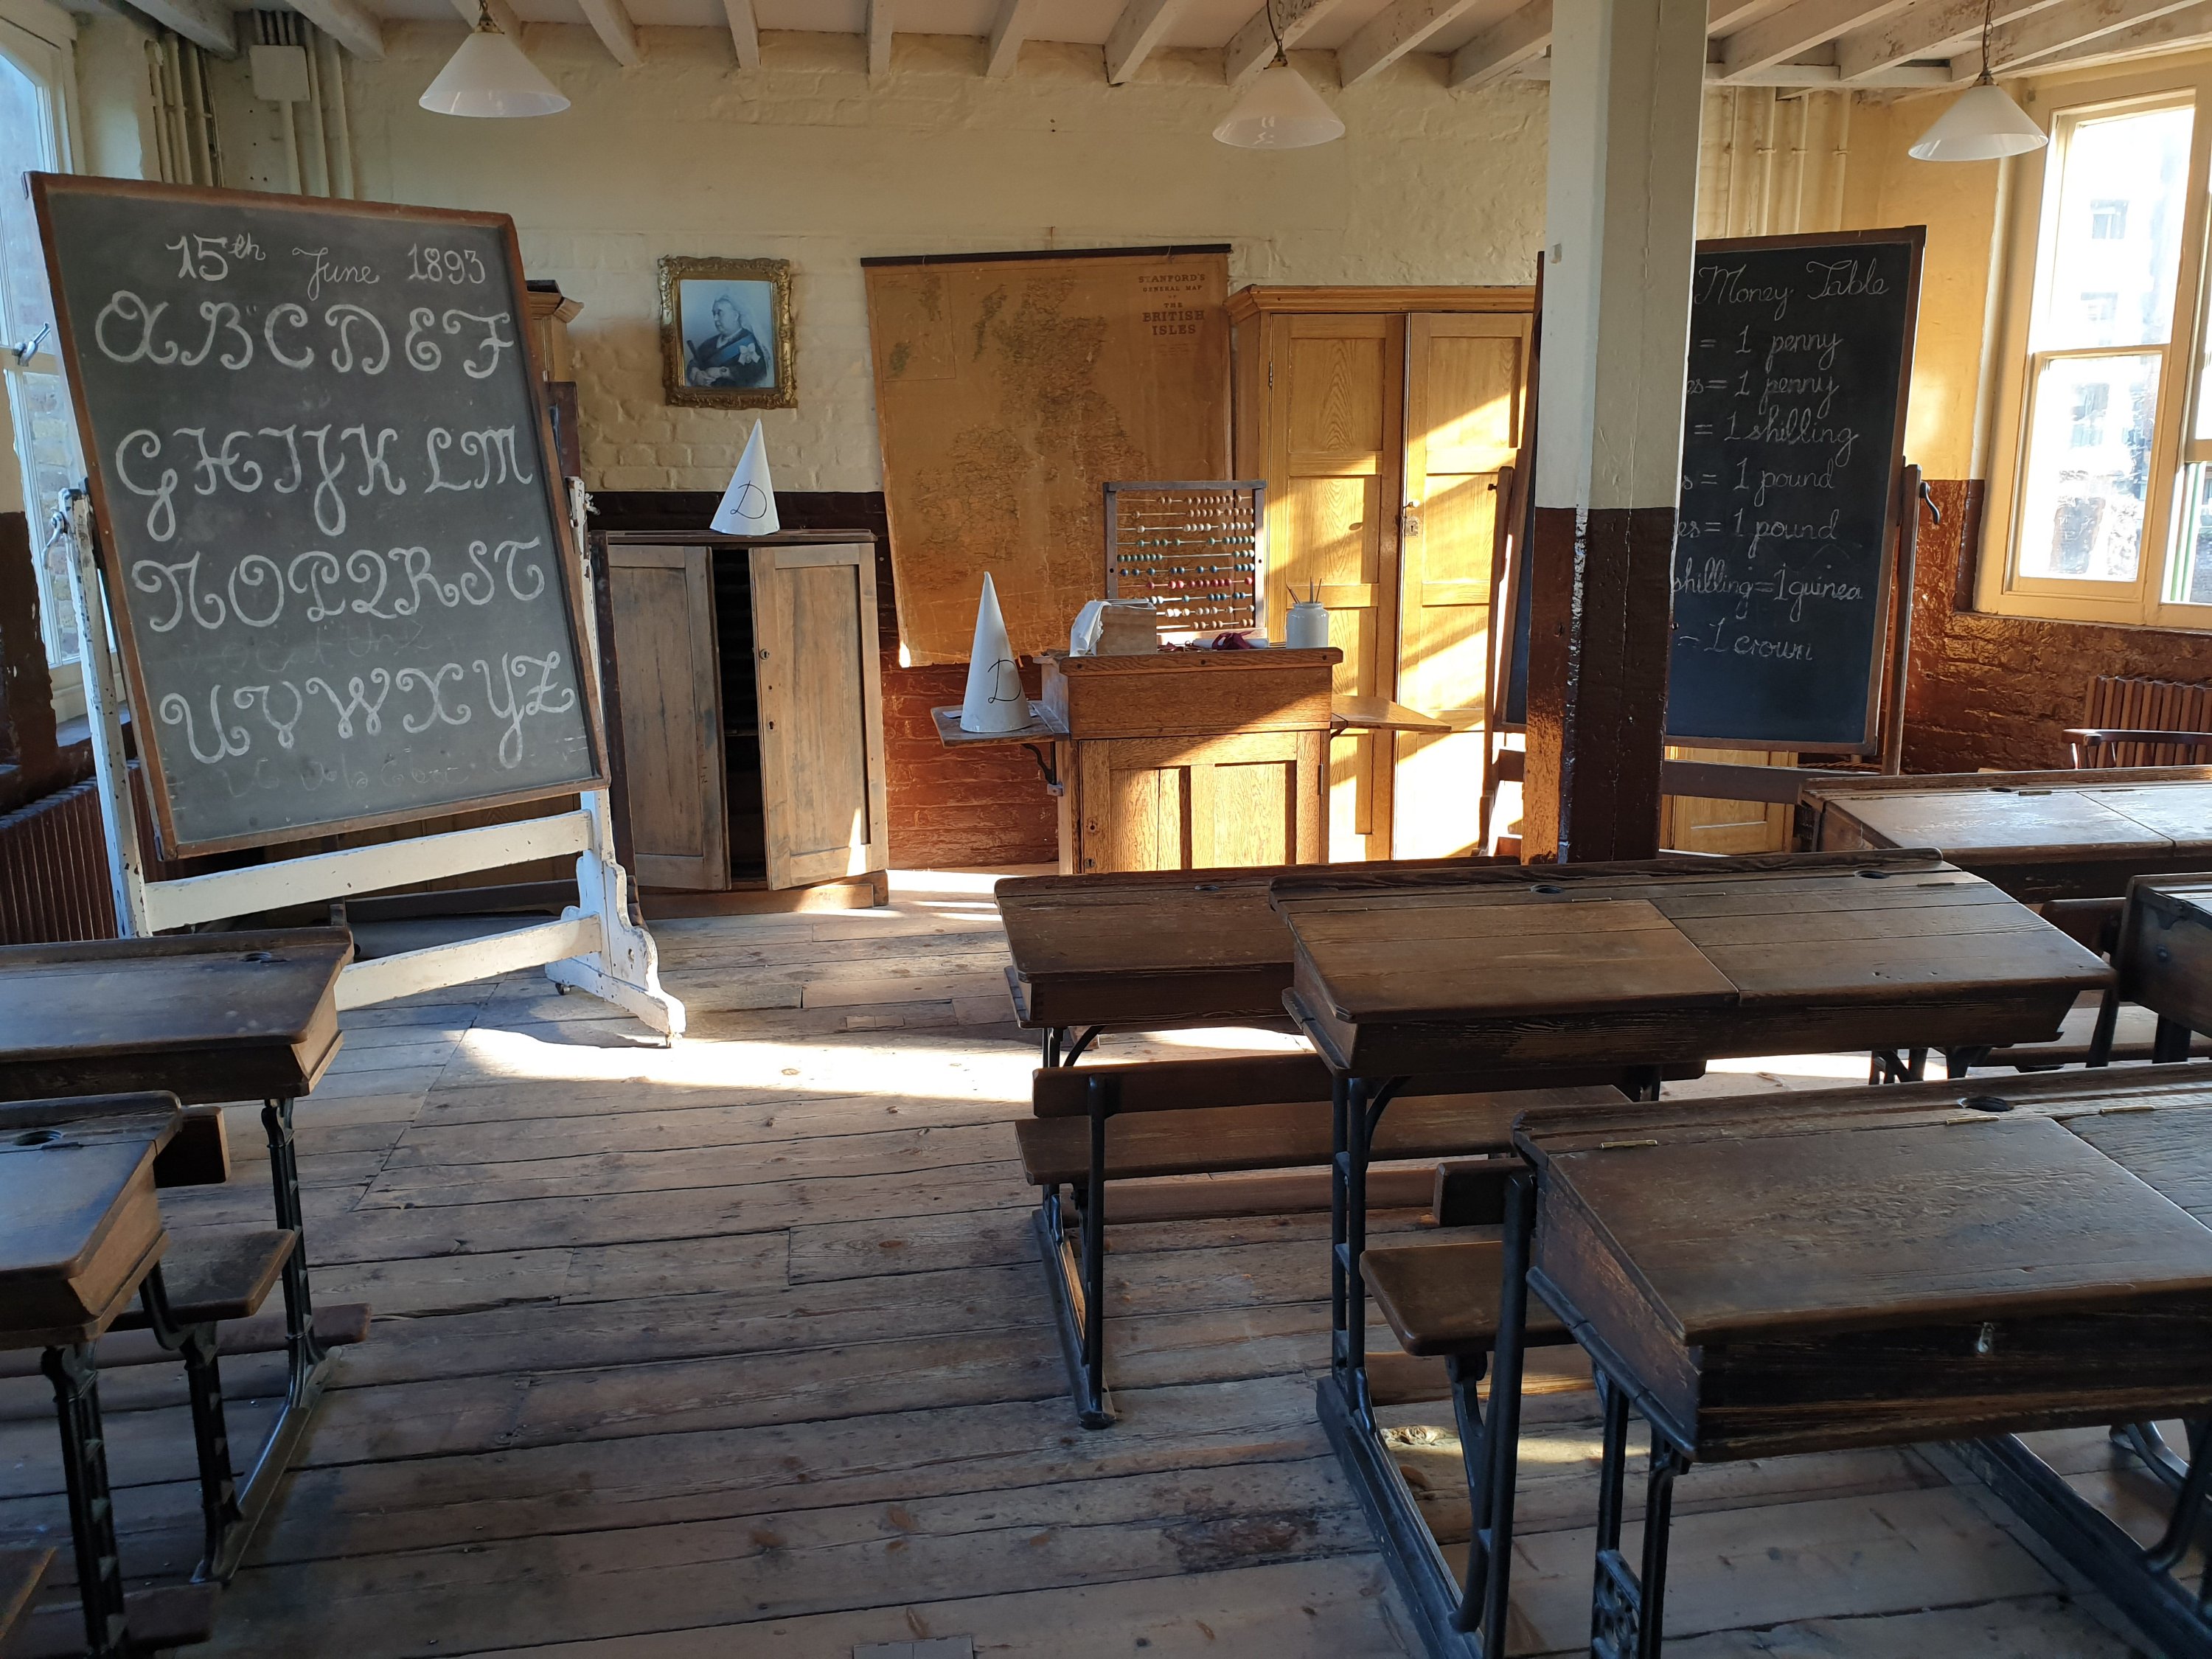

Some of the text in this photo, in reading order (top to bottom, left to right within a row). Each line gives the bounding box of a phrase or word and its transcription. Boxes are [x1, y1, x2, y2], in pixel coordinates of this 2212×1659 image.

[165, 232, 485, 302] 15th June 1893
[1694, 257, 1889, 321] Money Table
[1143, 310, 1205, 322] BRITISH
[1152, 324, 1196, 335] ISLES
[1765, 331, 1843, 375] penny
[1758, 375, 1840, 420] penny
[1744, 403, 1860, 467] shilling
[730, 480, 768, 519] D
[1753, 459, 1835, 507] pound
[1747, 509, 1840, 560] pound
[1734, 636, 1813, 661] crown
[987, 658, 1021, 703] D
